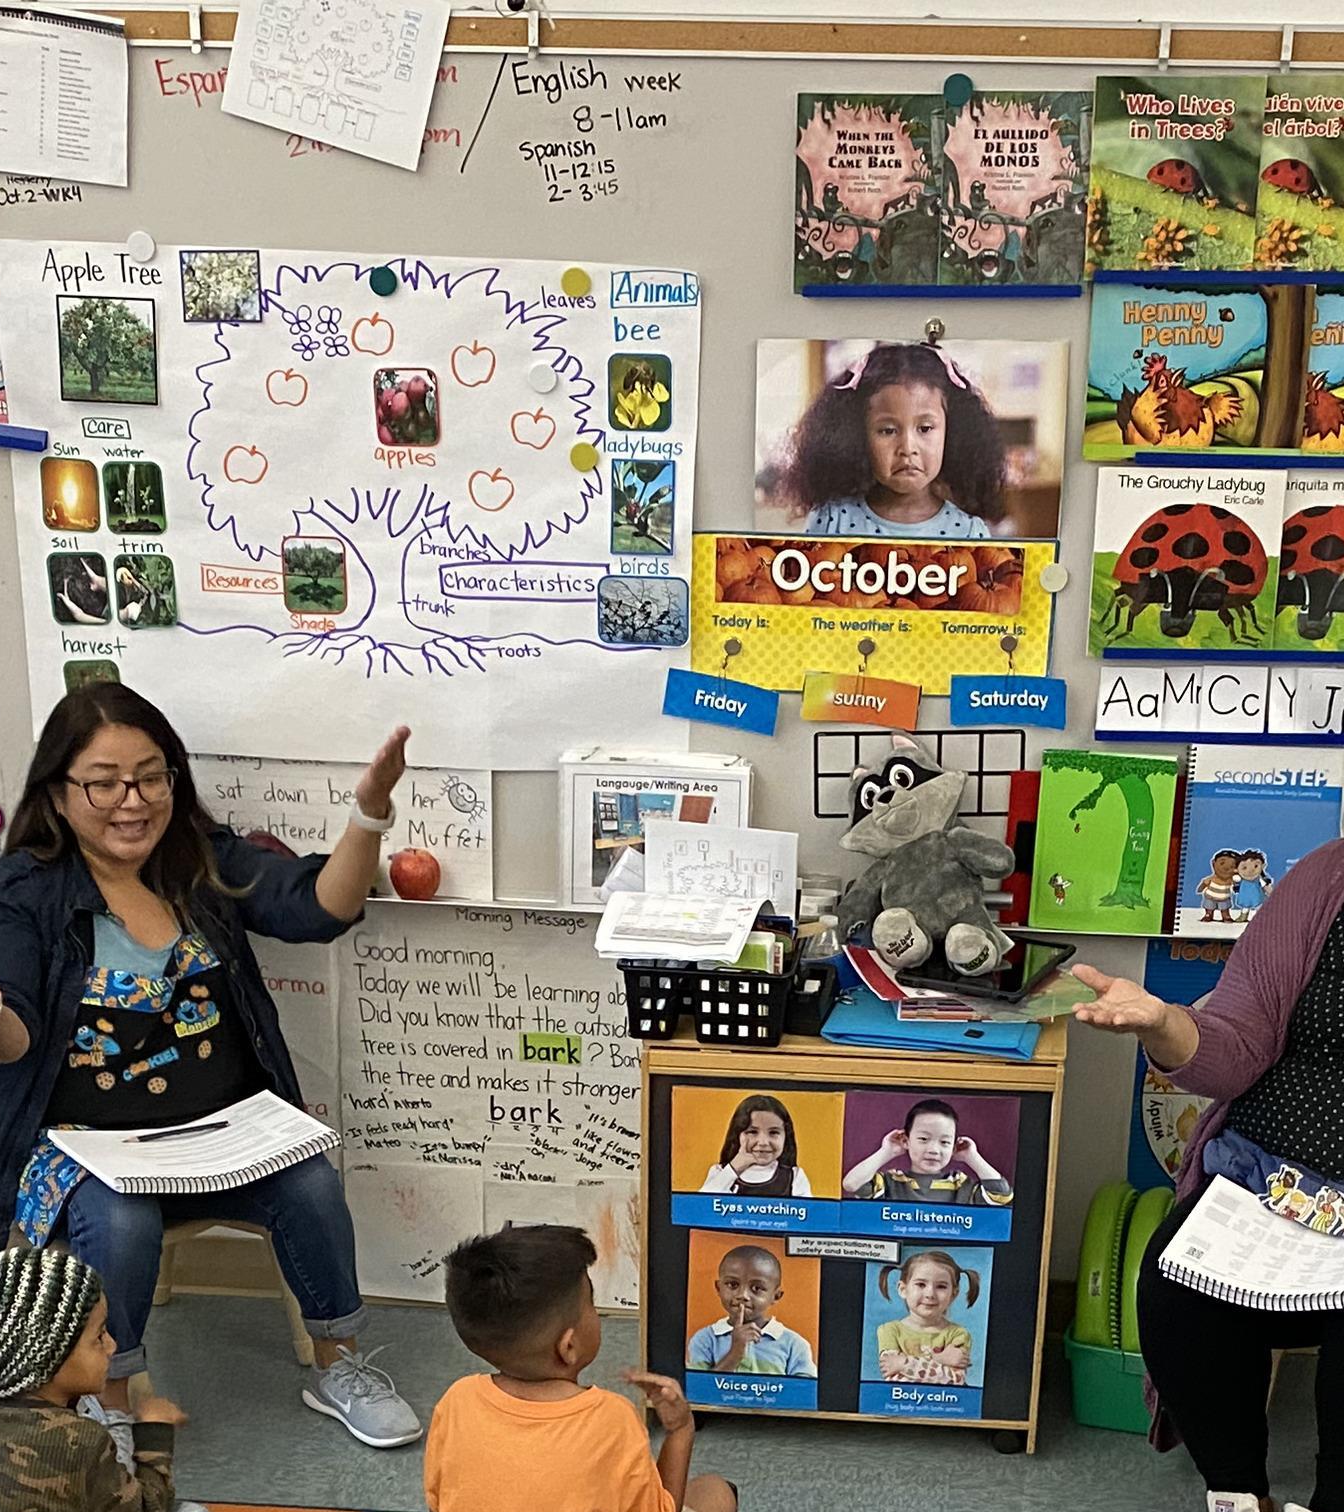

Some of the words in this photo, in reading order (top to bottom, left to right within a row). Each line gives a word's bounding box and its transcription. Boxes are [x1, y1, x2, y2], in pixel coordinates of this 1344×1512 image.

[512, 59, 606, 103] English
[1127, 94, 1174, 116] Who
[1178, 95, 1235, 116] Lives
[1284, 117, 1342, 138] árbol?
[520, 140, 596, 166] Spanish
[984, 142, 1007, 153] DE
[1010, 142, 1038, 154] LOS
[980, 155, 1040, 168] MONOS
[42, 249, 106, 292] Apple
[114, 253, 163, 285] Tree
[615, 273, 697, 304] Animals
[1123, 300, 1207, 324] Henny
[614, 316, 661, 341] bee
[1141, 323, 1223, 348] Penny
[374, 446, 437, 470] apples
[1118, 475, 1143, 489] The
[1147, 475, 1203, 493] Grouchy
[1207, 476, 1265, 495] Ladybug
[619, 558, 670, 575] birds
[771, 548, 967, 595] October
[207, 570, 279, 590] Resources
[712, 615, 752, 630] Today
[756, 615, 770, 629] is:
[812, 617, 836, 631] The
[840, 618, 894, 633] weather
[899, 620, 912, 633] is:
[941, 622, 1007, 636] Tomorrow
[62, 631, 127, 657] harvest
[498, 644, 541, 658] roots
[694, 690, 747, 718] Friday
[834, 692, 886, 712] sunny
[970, 690, 1048, 711] Saturday
[263, 781, 308, 804] down
[693, 781, 719, 793] Area
[408, 820, 485, 849] Muffet
[456, 907, 513, 932] Morning
[523, 912, 588, 935] Message
[354, 931, 409, 964] Good
[354, 962, 410, 1002] Today
[445, 972, 482, 998] will
[526, 973, 600, 1014] learning
[359, 998, 393, 1024] Did
[400, 1010, 429, 1034] you
[433, 1001, 480, 1028] know
[484, 1002, 526, 1031] that
[532, 1006, 569, 1034] the
[360, 1030, 396, 1056] tree
[424, 1037, 488, 1061] covered
[522, 1033, 581, 1064] bark
[361, 1062, 392, 1085] the
[396, 1066, 436, 1088] tree
[440, 1065, 471, 1090] and
[476, 1068, 529, 1093] makes
[1146, 1100, 1164, 1140] windy
[713, 1199, 743, 1215] Eyes
[747, 1203, 807, 1221] watching
[882, 1207, 912, 1221] Ears
[915, 1208, 973, 1228] listening
[715, 1378, 749, 1392] Voice
[751, 1380, 784, 1396] quiet
[892, 1387, 924, 1403] Body
[927, 1390, 958, 1403] calm
